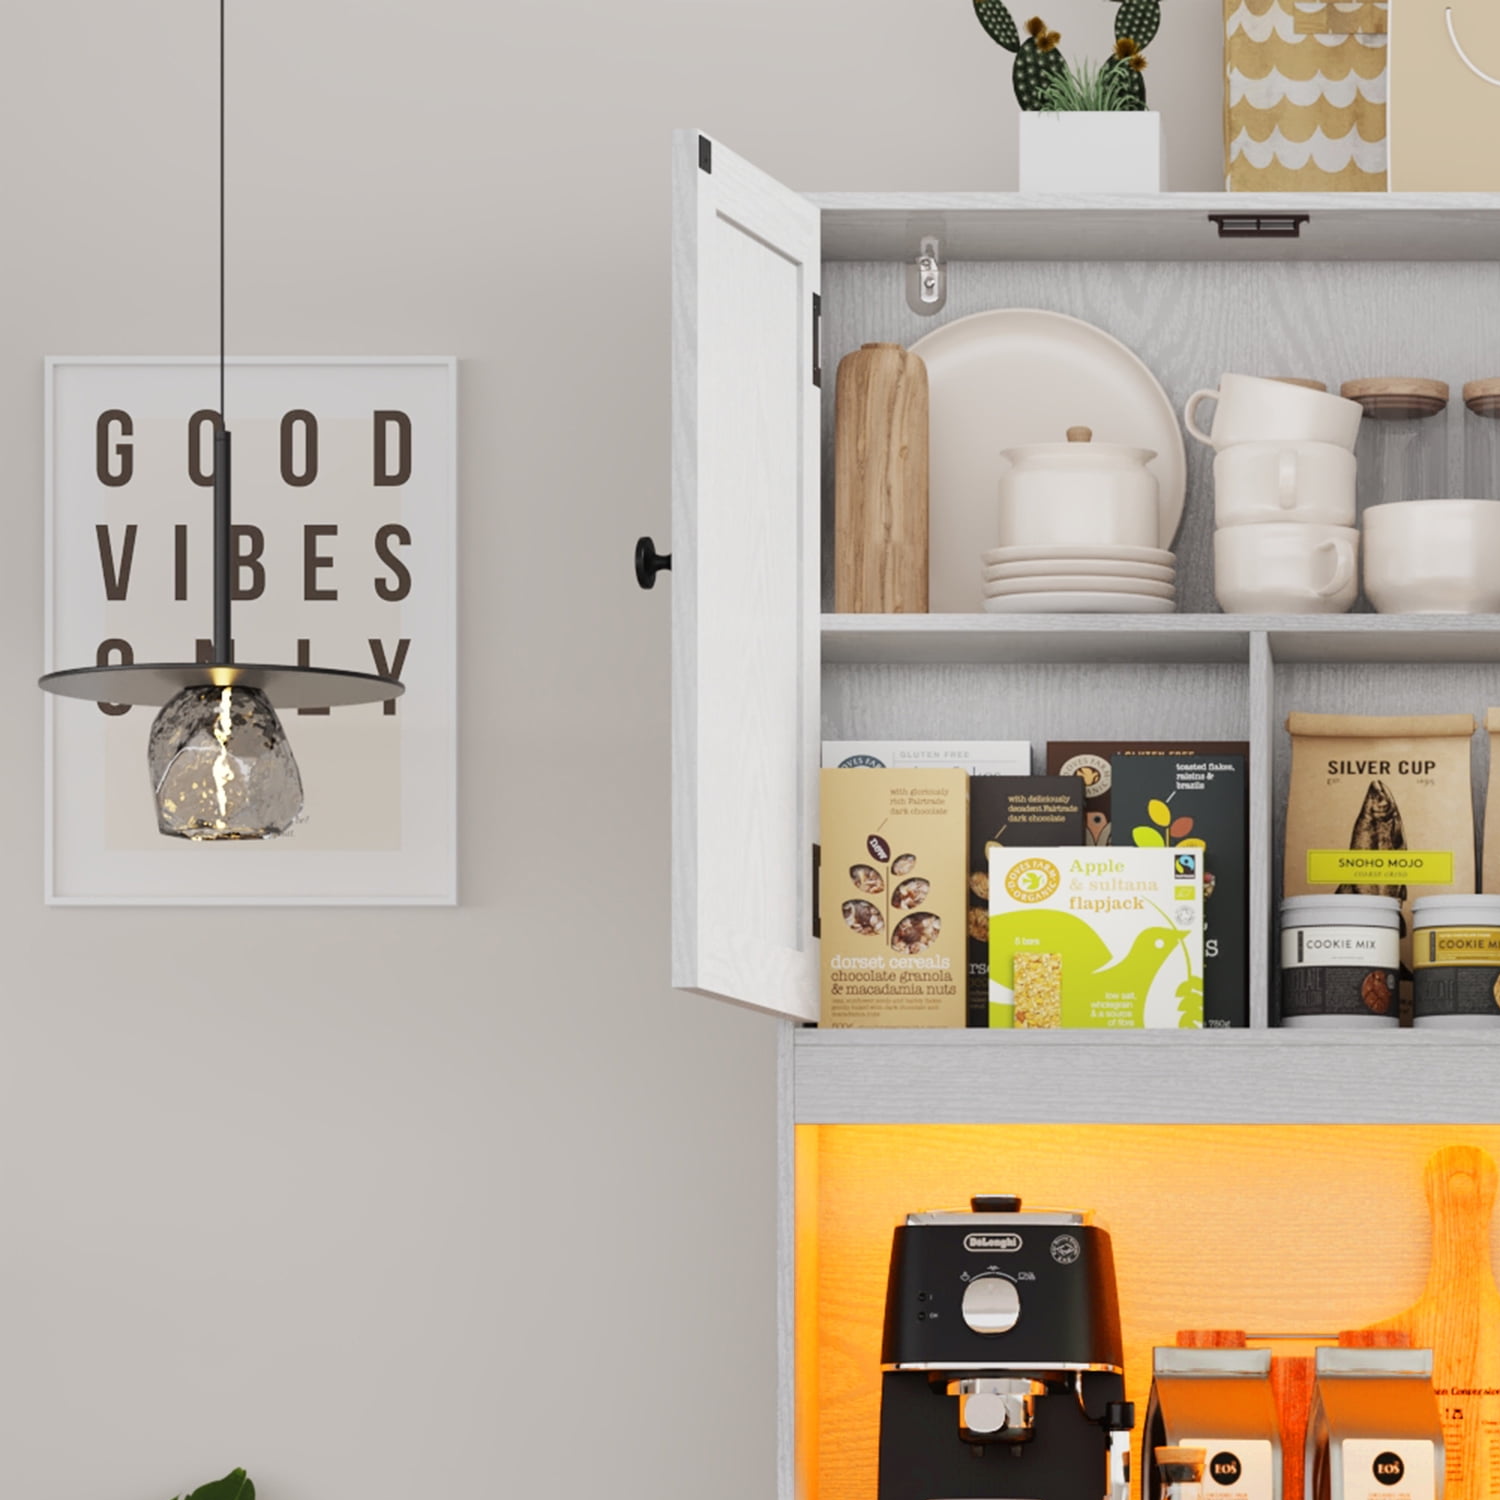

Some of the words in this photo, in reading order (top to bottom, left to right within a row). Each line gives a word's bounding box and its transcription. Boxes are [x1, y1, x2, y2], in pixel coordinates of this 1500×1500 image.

[95, 408, 412, 487] GOOD
[95, 524, 412, 602] VIBES
[1327, 760, 1391, 775] SILVER
[1398, 760, 1436, 775] CUP
[1008, 795, 1025, 804] with
[1008, 814, 1027, 823] dark
[870, 837, 888, 859] new
[1069, 859, 1125, 875] Apple
[1338, 859, 1384, 868] SNOHO
[1388, 859, 1424, 869] MOJO
[1069, 880, 1083, 892] &
[1089, 879, 1159, 892] sultana
[1069, 896, 1145, 913] flapjack
[1306, 939, 1352, 950] COOKIE
[1355, 939, 1377, 950] MIX
[1438, 939, 1484, 950] COOKIE
[831, 955, 884, 969] dorset
[889, 955, 950, 969] cereals
[831, 970, 896, 982] chocolate
[900, 970, 952, 984] granola
[831, 984, 844, 996] &
[846, 984, 923, 996] macadamia
[926, 984, 957, 996] nuts
